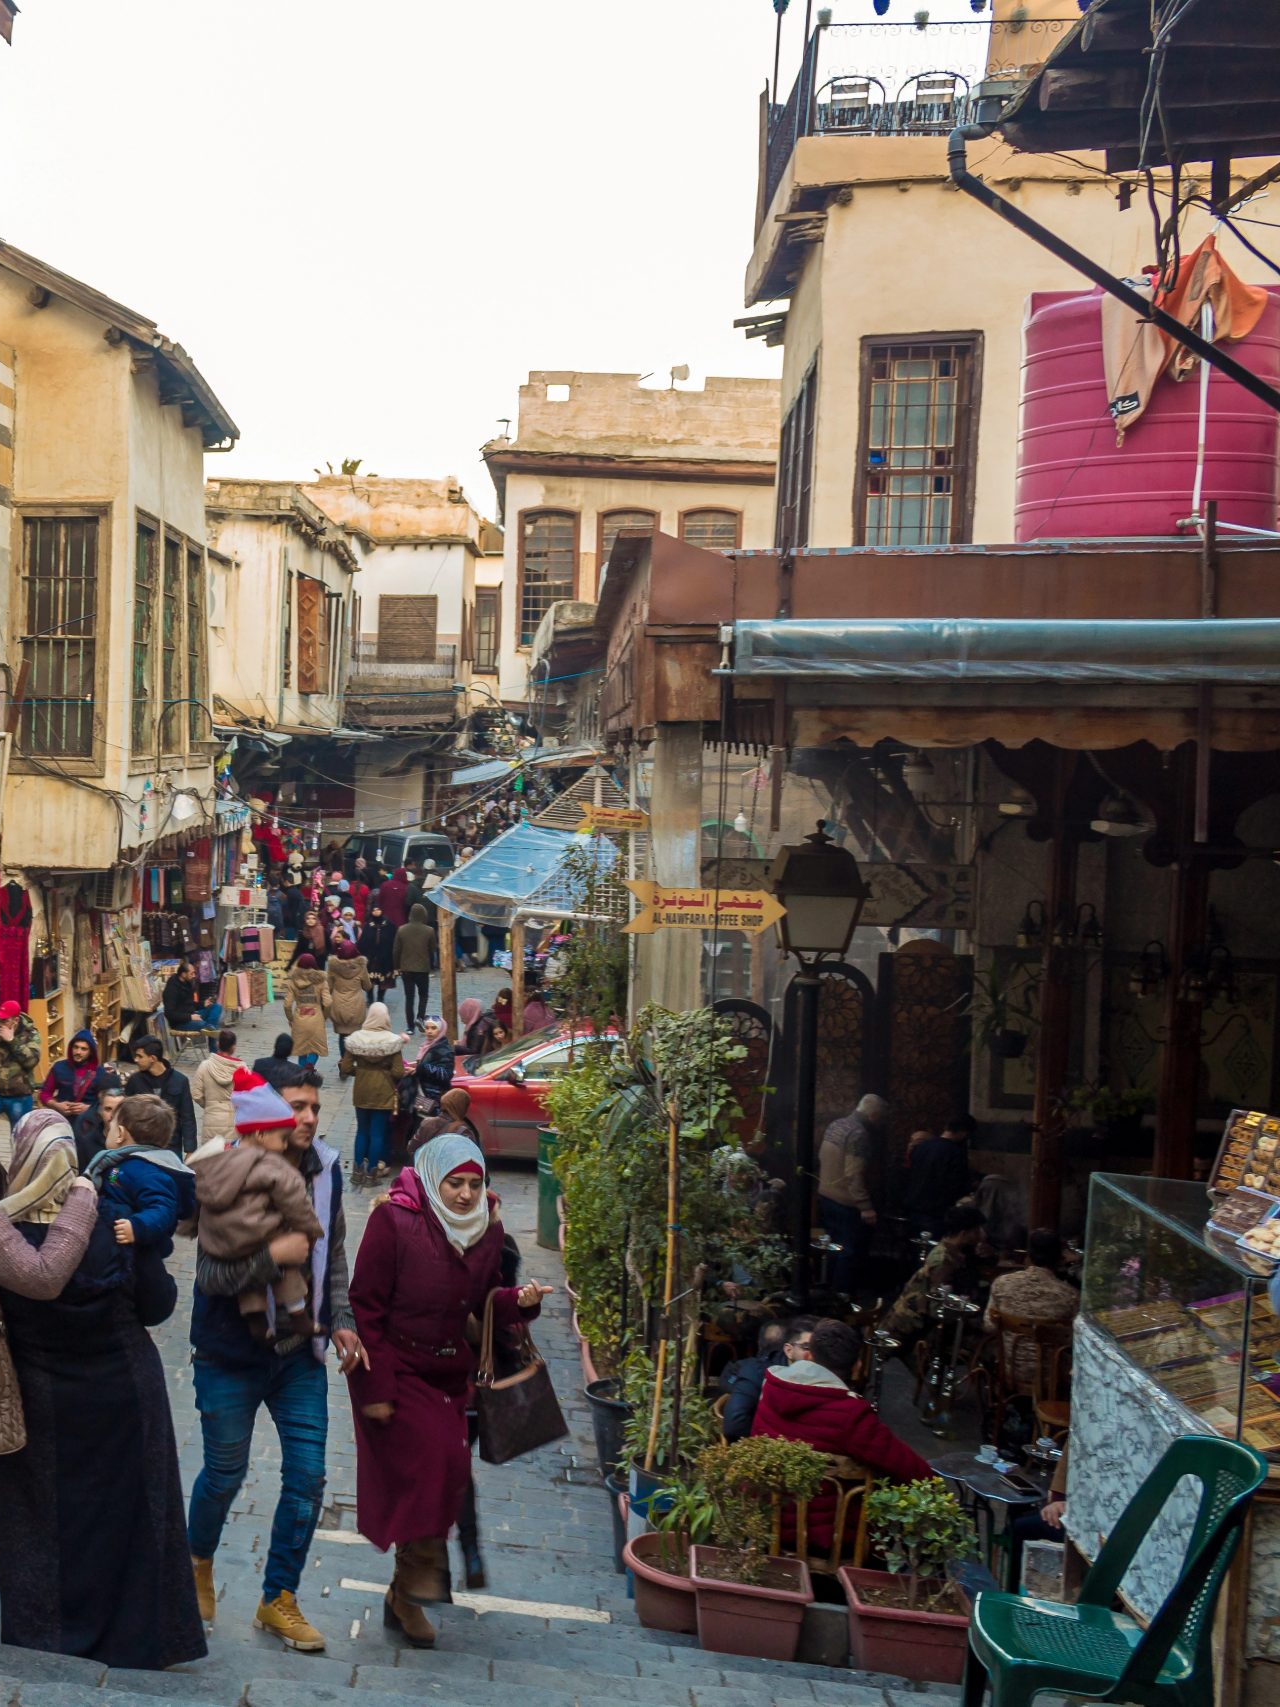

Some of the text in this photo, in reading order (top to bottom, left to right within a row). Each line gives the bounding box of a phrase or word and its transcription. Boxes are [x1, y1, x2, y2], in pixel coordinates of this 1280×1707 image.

[652, 891, 763, 912] مقهى النوفرة
[653, 912, 706, 925] AL-NAWFARA
[741, 915, 763, 927] SHOP
